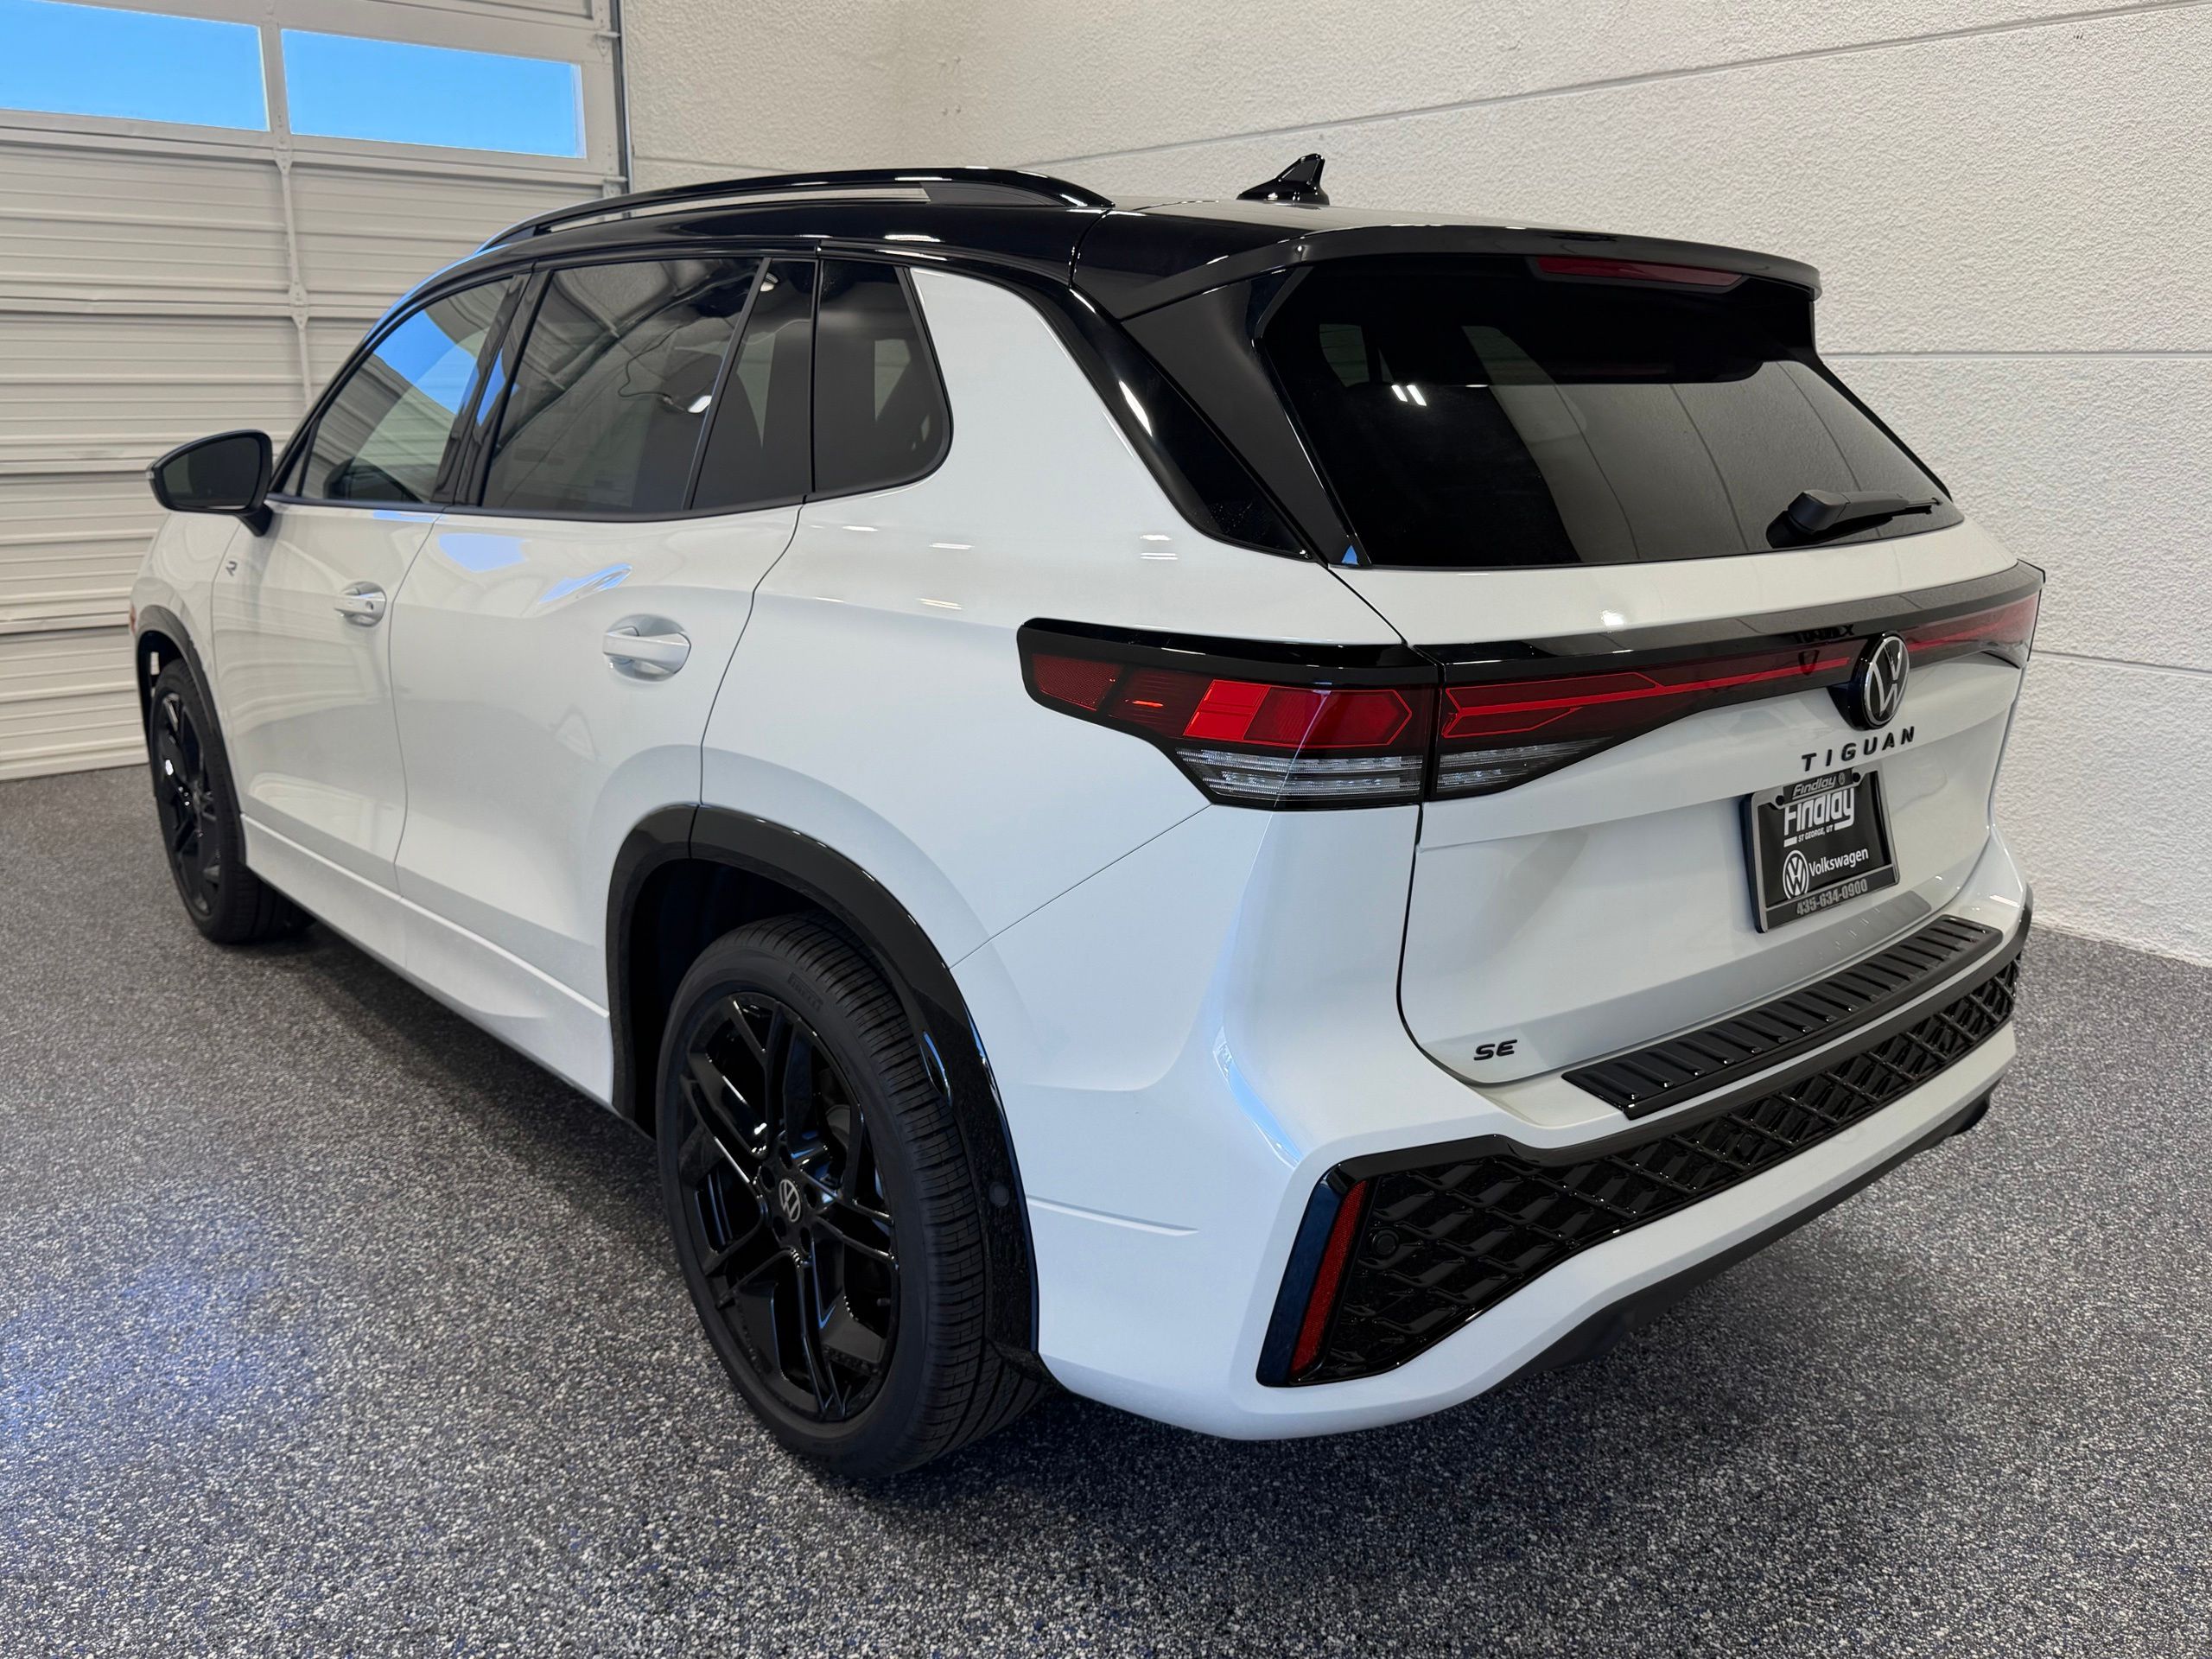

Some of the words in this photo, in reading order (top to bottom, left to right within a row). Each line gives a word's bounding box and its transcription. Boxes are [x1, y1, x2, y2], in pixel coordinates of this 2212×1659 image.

[1801, 726, 1915, 772] TIGUAN
[1792, 776, 1837, 797] Findlay
[1808, 848, 1869, 877] Volkswagen
[1796, 878, 1868, 916] 435-634-0900
[1473, 1039, 1518, 1061] SE
